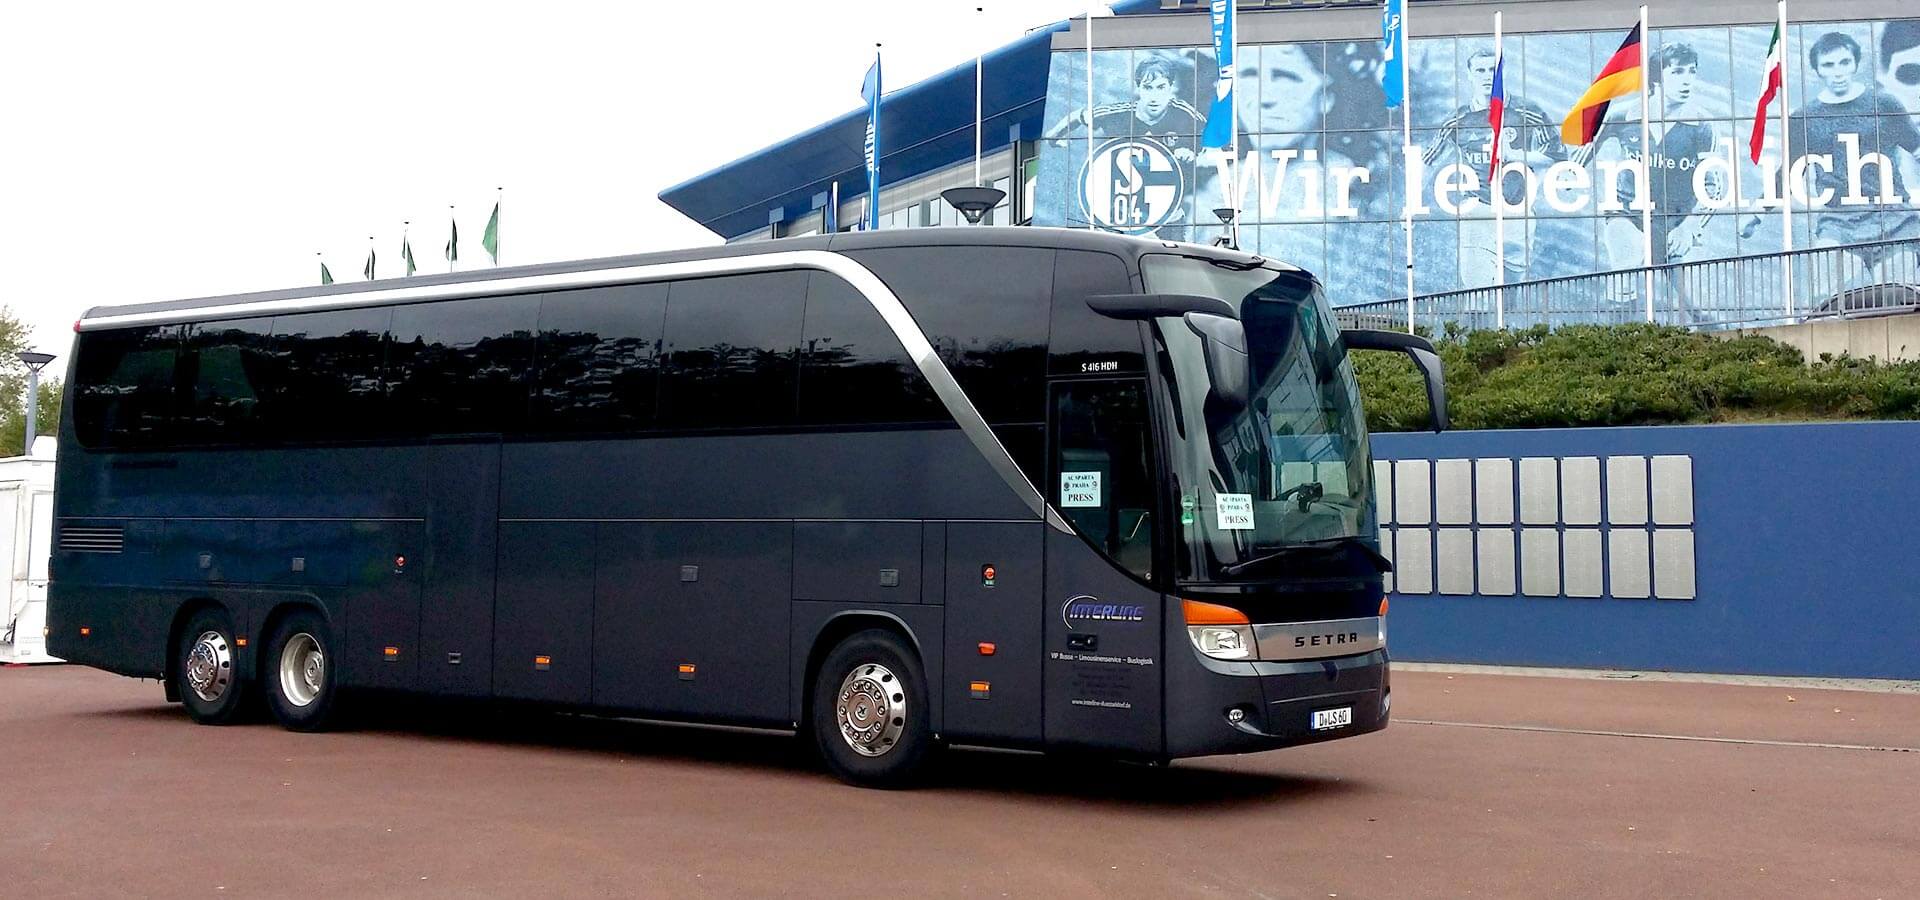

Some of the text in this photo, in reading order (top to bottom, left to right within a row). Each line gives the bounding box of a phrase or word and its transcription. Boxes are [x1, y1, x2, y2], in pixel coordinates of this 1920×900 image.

[1206, 148, 1370, 219] Wir
[1402, 145, 1656, 216] leben
[1081, 361, 1118, 372] S 416 HDH
[1068, 493, 1094, 502] PRESS
[1224, 515, 1249, 524] PRESS
[1069, 603, 1144, 621] INTERLINE
[1295, 632, 1358, 648] SETRA
[1050, 652, 1059, 660] VIP
[1059, 652, 1074, 661] Busse
